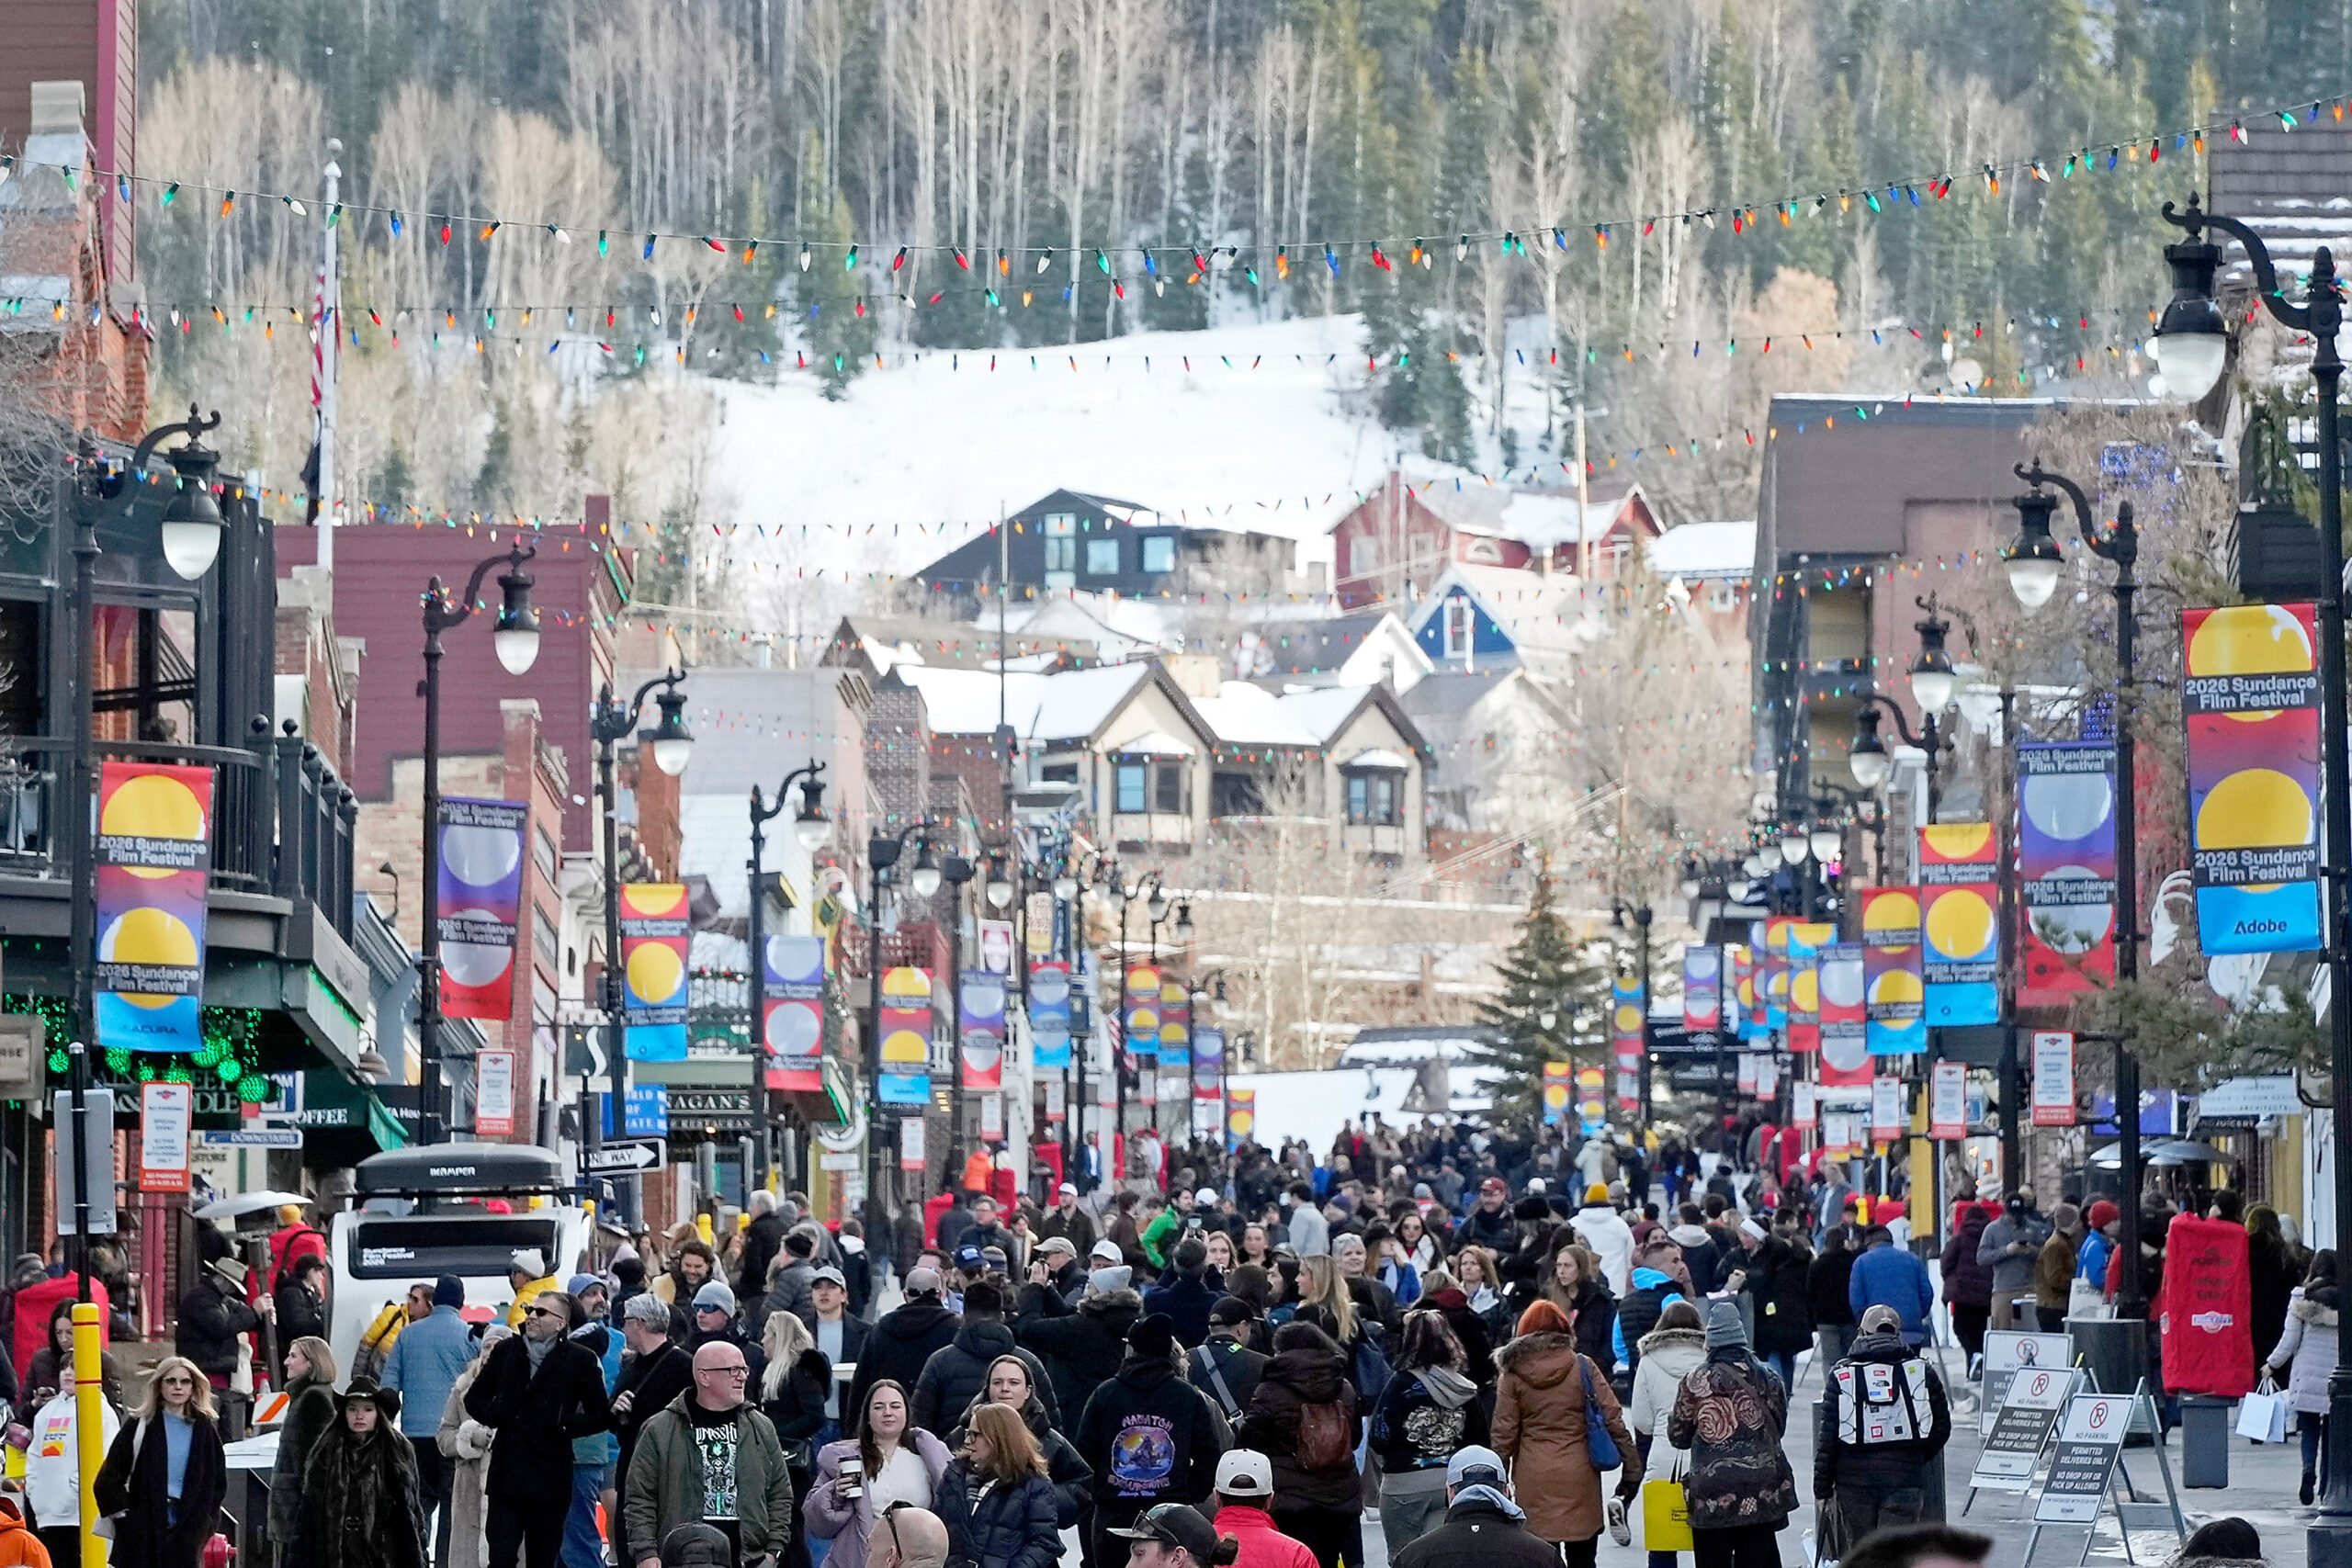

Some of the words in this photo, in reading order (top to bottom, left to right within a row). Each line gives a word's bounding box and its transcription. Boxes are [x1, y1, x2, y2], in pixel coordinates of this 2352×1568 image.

[2186, 679, 2229, 695] 2026
[2232, 675, 2317, 692] Sundance
[2199, 694, 2236, 709] Film
[2239, 690, 2305, 707] Festival
[2018, 749, 2051, 762] 2026
[2052, 748, 2116, 761] Sundance
[2029, 760, 2055, 773] Film
[2057, 758, 2105, 771] Festival
[471, 804, 526, 819] Sundance
[474, 814, 516, 828] Festival
[99, 835, 134, 851] 2026
[135, 837, 207, 855] Sundance
[108, 848, 139, 863] Film
[141, 850, 196, 866] Festival
[2195, 852, 2238, 868] 2026
[2241, 849, 2315, 865] Sundance
[2209, 867, 2245, 883] Film
[2249, 863, 2307, 880] Festival
[2023, 881, 2054, 894] 2026
[2056, 879, 2115, 892] Sundance
[2032, 893, 2059, 905] Film
[2061, 891, 2107, 904] Festival
[2234, 919, 2287, 935] Adobe
[97, 964, 130, 977] 2026
[131, 964, 199, 981] Sundance
[107, 977, 134, 991] Film
[136, 978, 188, 993] Festival
[132, 1024, 178, 1034] ACURA
[610, 1149, 632, 1161] WAY
[2012, 1411, 2043, 1419] PERMITTED
[2002, 1418, 2030, 1427] DELIVERIES
[2030, 1420, 2046, 1428] ONLY
[1997, 1431, 2006, 1439] NO
[2006, 1432, 2020, 1440] DROP
[2012, 1441, 2038, 1450] ALLOWED
[2071, 1446, 2103, 1455] PERMITTED
[2060, 1456, 2091, 1465] DELIVERIES
[2056, 1471, 2065, 1479] NO
[2065, 1472, 2082, 1480] DROP
[2082, 1472, 2092, 1480] OFF
[2051, 1481, 2065, 1489] PICK
[2064, 1481, 2075, 1489] UP
[2075, 1482, 2100, 1490] ALLOWED
